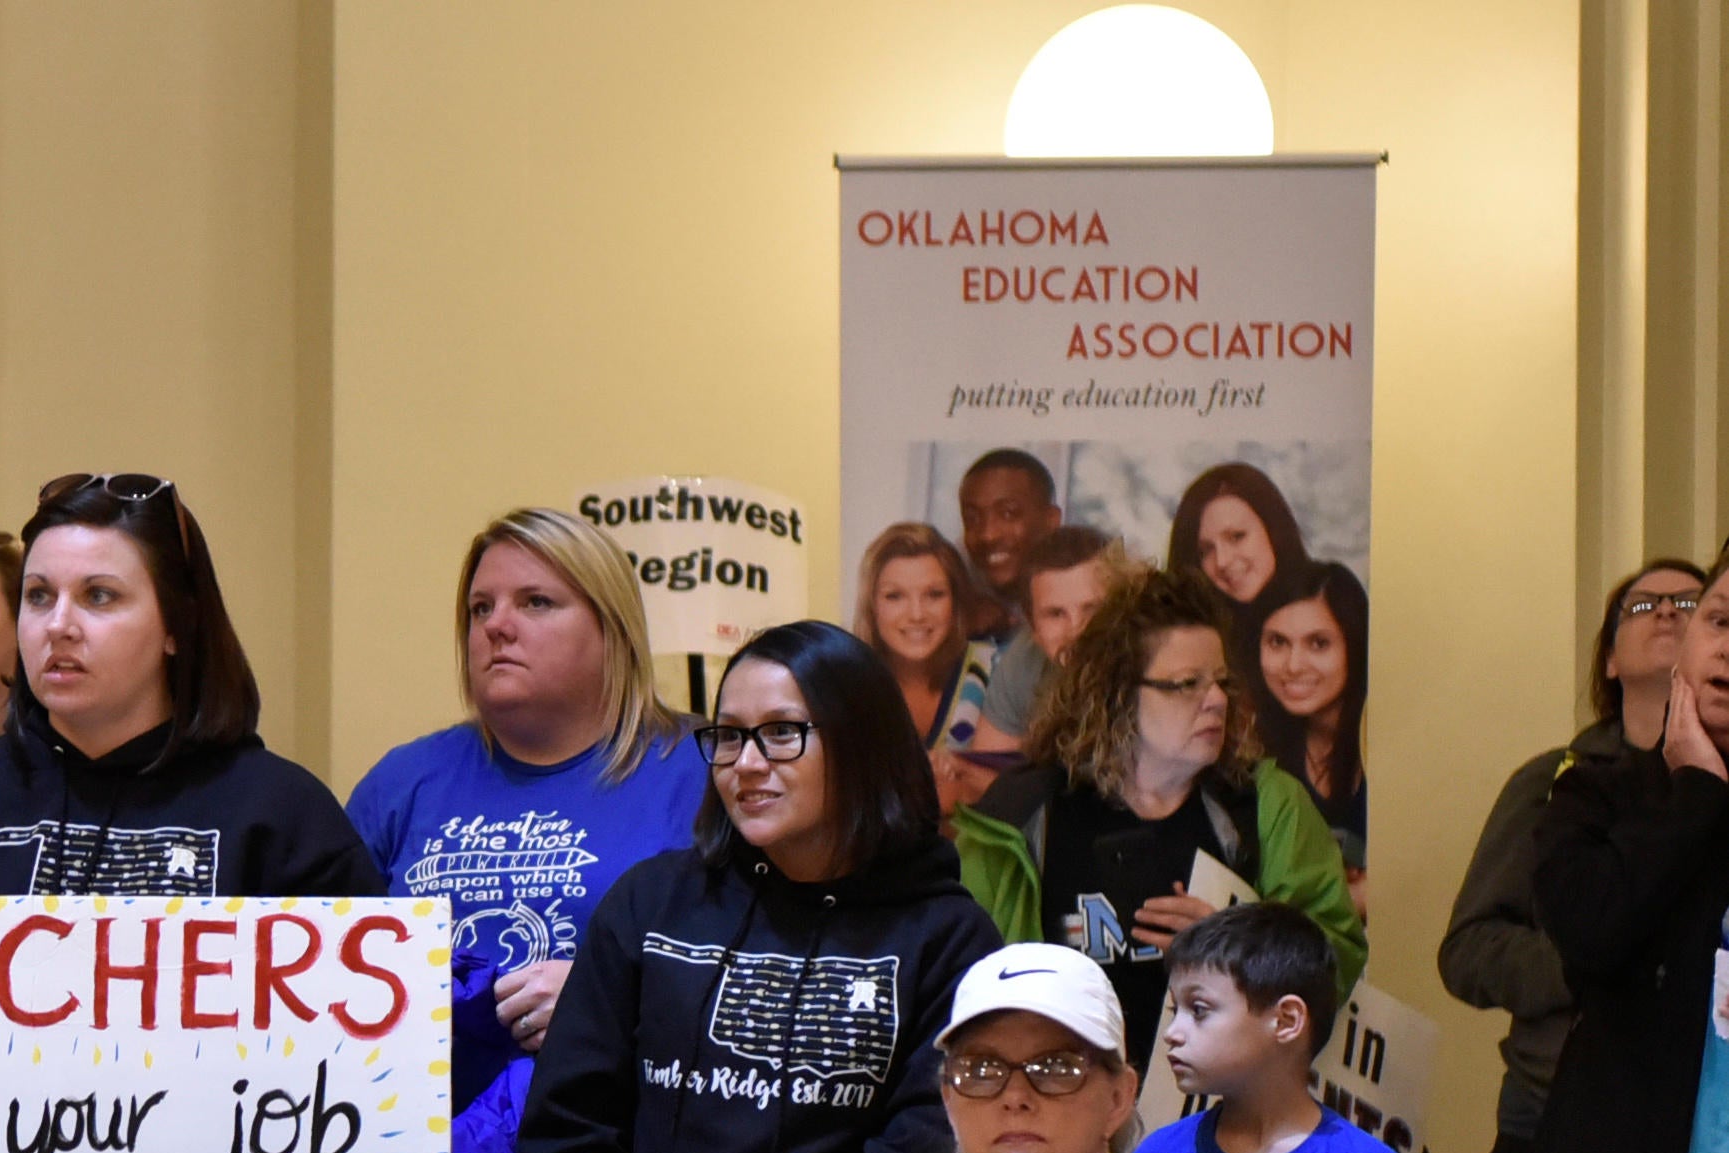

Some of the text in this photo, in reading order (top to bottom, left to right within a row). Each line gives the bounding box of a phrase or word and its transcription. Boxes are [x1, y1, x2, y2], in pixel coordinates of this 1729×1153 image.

[858, 210, 1109, 247] OKLAHOMA
[962, 266, 1199, 303] EDUCATION
[1066, 322, 1353, 360] ASSOCIATION
[947, 378, 1266, 419] putting education first
[579, 486, 802, 544] Southwest
[423, 828, 588, 854] is the most
[440, 810, 572, 839] Education
[446, 855, 559, 872] POWERFUL
[409, 875, 500, 896] weapon
[510, 869, 582, 884] which
[460, 889, 504, 902] can
[512, 886, 553, 899] use
[562, 884, 587, 898] to
[1342, 1001, 1386, 1084] in
[643, 1058, 875, 1110] Timber Ridge Est. 2017
